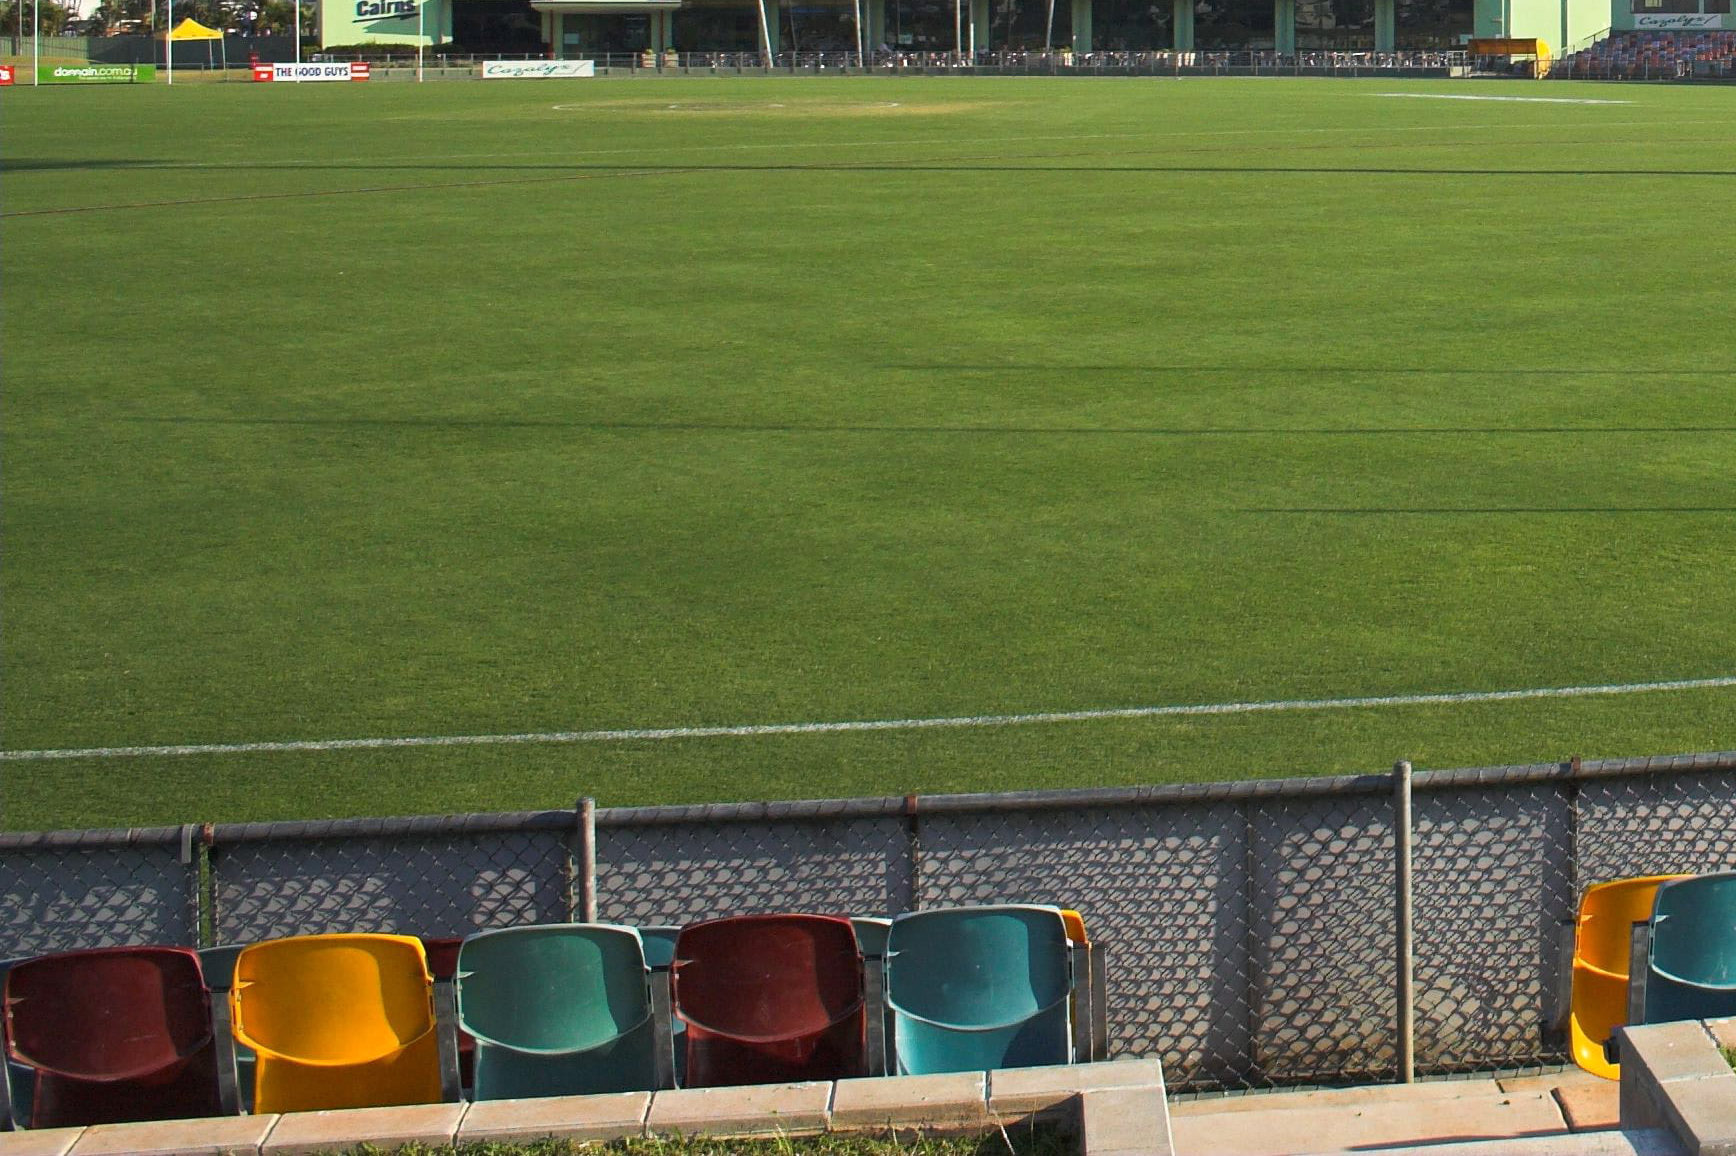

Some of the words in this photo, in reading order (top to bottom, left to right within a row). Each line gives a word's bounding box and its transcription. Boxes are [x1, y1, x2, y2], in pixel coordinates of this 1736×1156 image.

[356, 0, 416, 16] Cairns
[276, 67, 292, 76] THE
[296, 67, 321, 76] GOOD
[325, 67, 348, 76] GUYS
